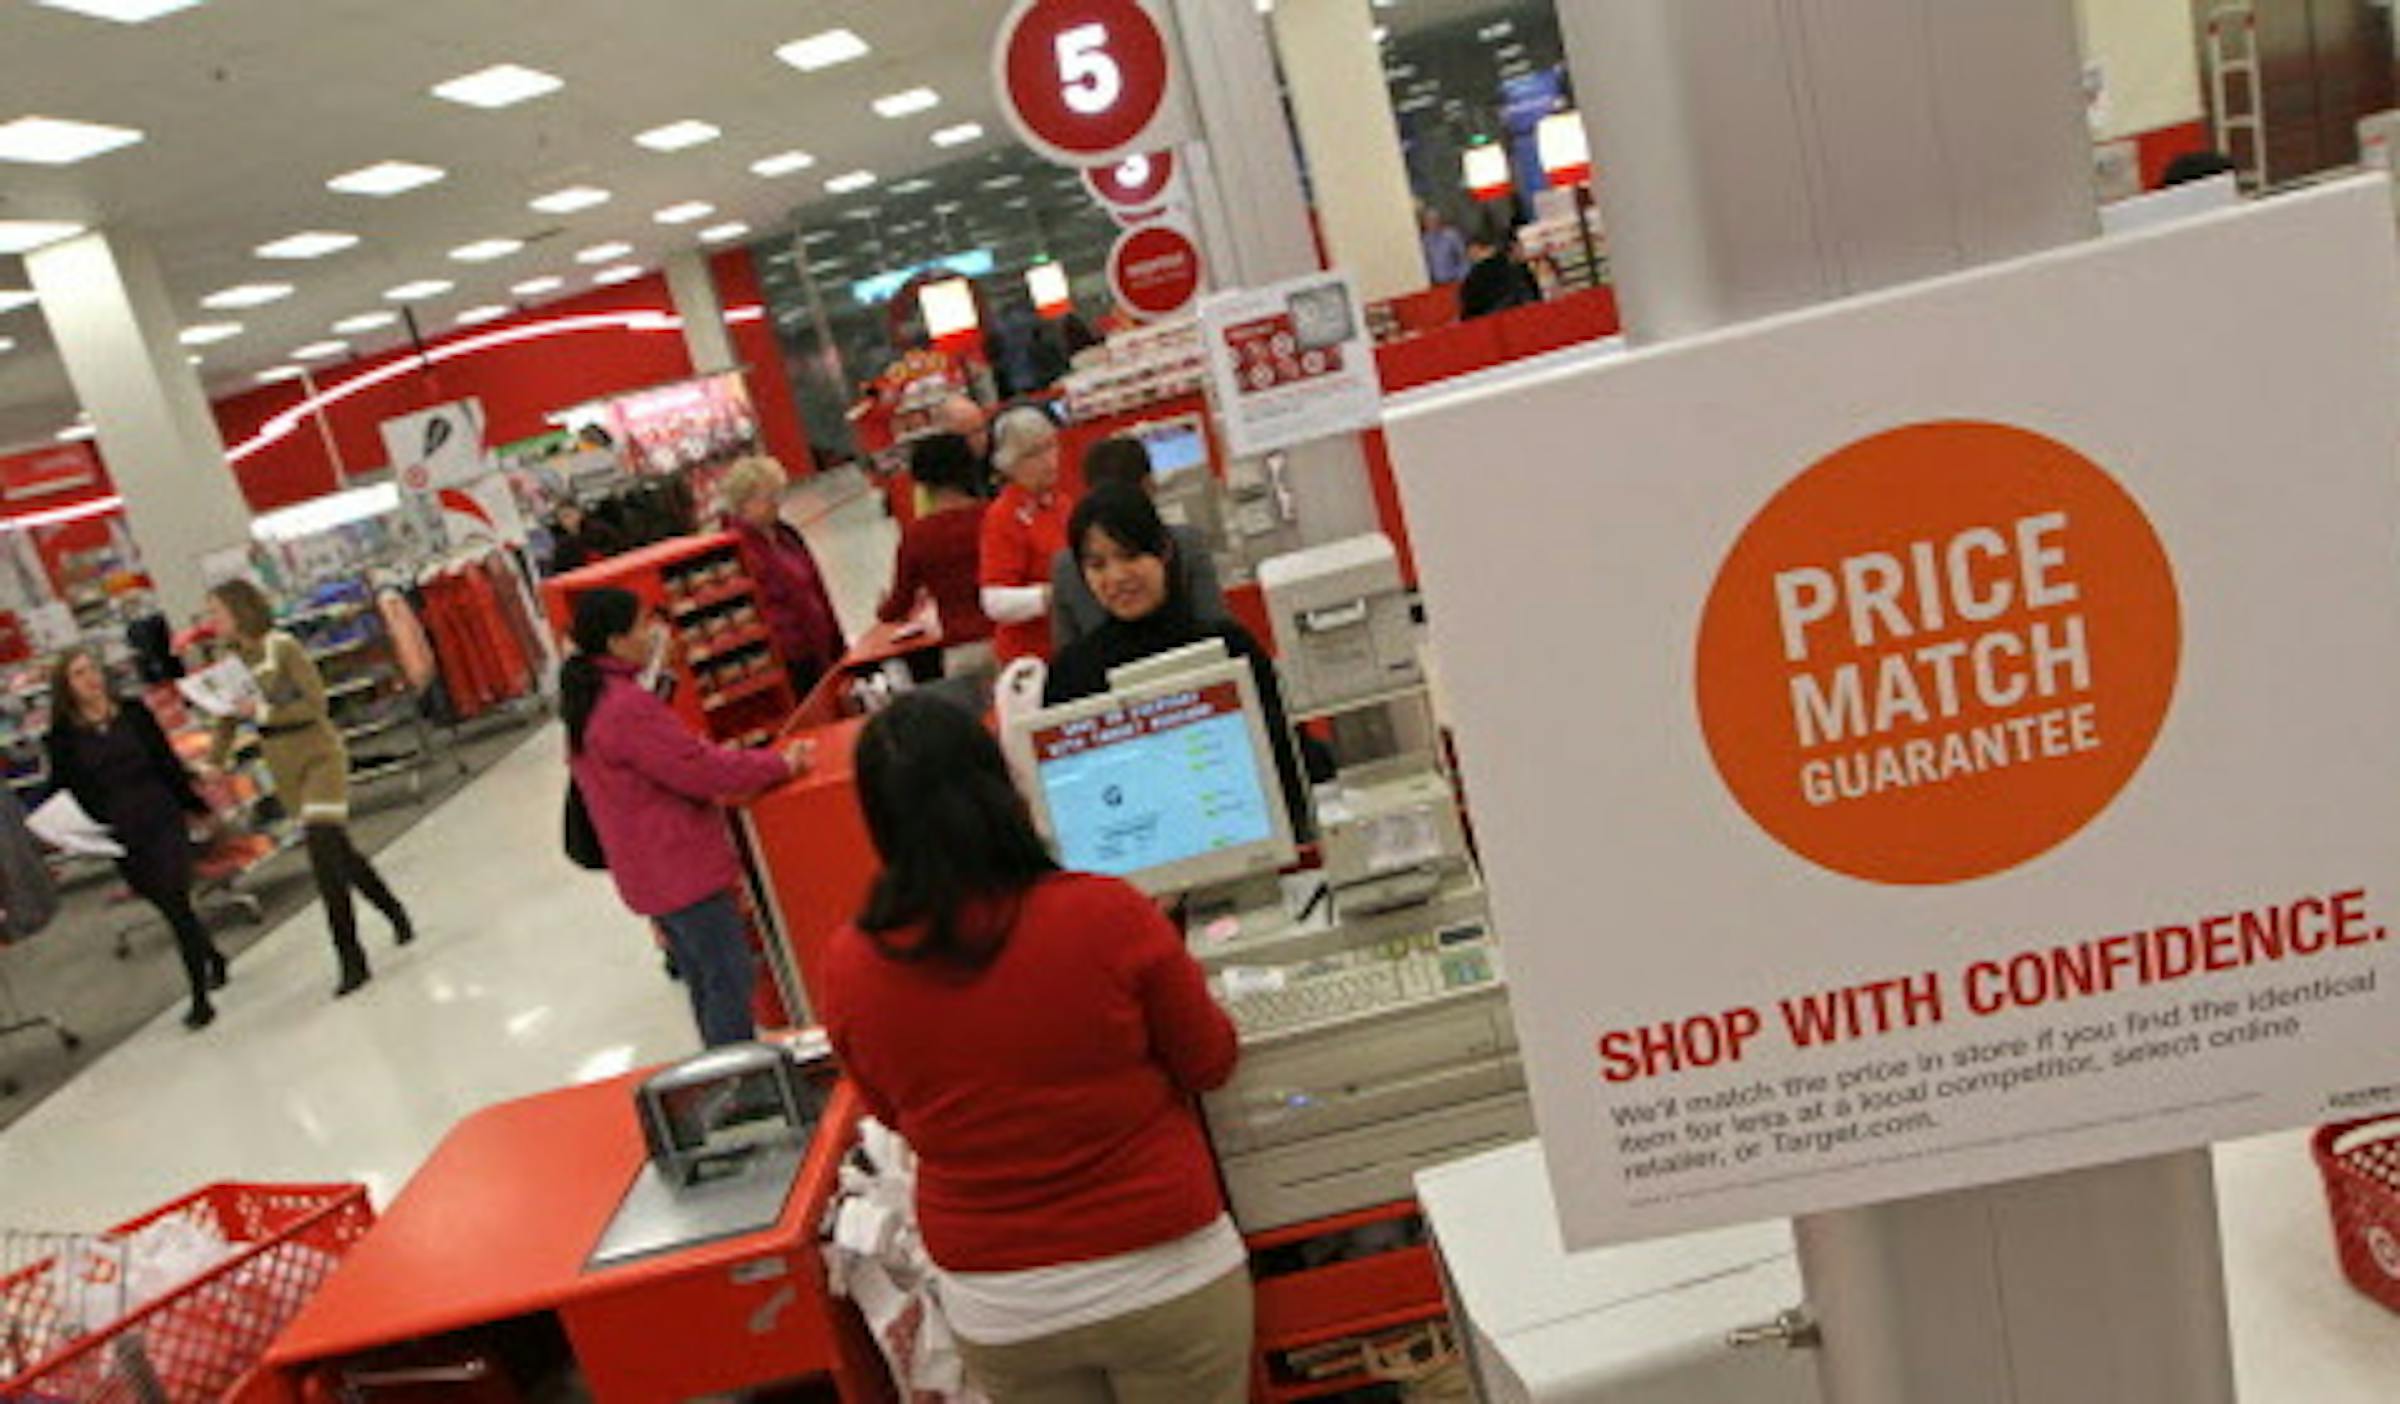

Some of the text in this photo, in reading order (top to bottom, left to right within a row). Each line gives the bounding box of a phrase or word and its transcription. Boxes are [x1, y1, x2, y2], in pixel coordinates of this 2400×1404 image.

[1055, 23, 1120, 114] 5
[1774, 511, 2079, 662] PRICE
[1790, 614, 2091, 748] MATCH
[1802, 703, 2100, 806] GUARANTEE
[1598, 888, 2387, 1083] SHOP WITH CONFIDENCE.
[1609, 970, 2376, 1128] We'll match the price in store if you find the identical
[1617, 1016, 2300, 1154] item for less at a local competitor, select online
[1623, 1148, 1728, 1182] retailer,
[1734, 1144, 1761, 1163] or
[1771, 1111, 1939, 1152] Target.com.
